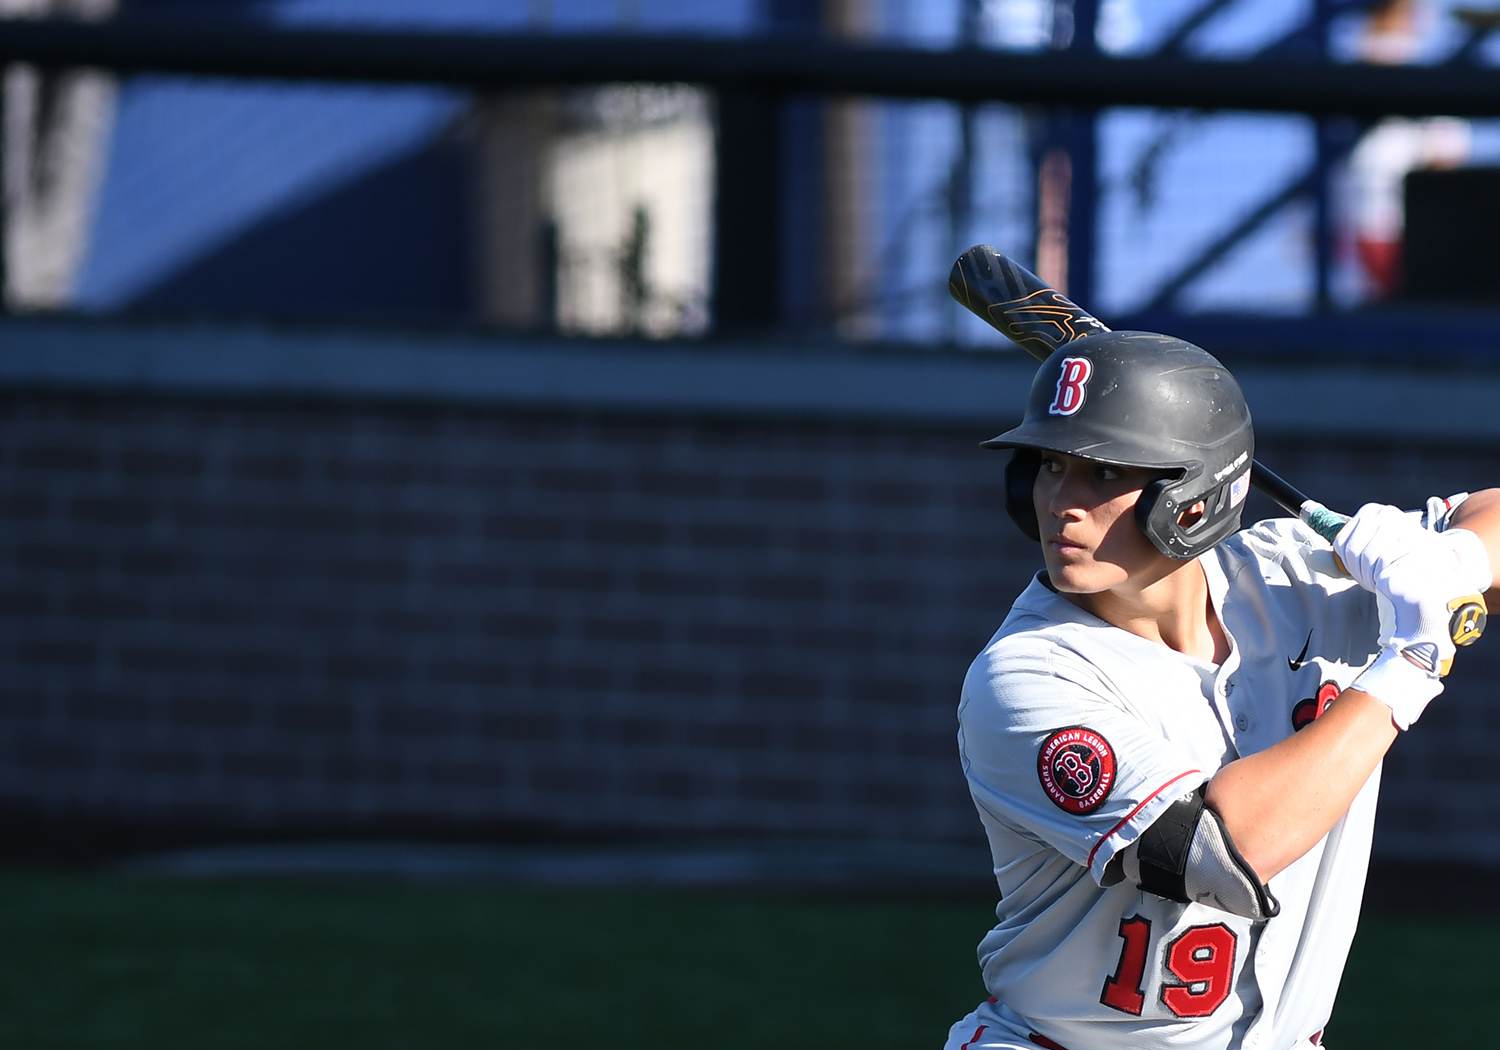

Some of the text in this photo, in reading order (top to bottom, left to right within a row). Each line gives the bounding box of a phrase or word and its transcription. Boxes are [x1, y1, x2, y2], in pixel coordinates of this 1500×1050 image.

[1049, 357, 1092, 416] B
[1042, 732, 1109, 803] BARBERS AMERICAN LEGION
[1055, 751, 1093, 794] B
[1078, 772, 1111, 809] BASEBALL
[1100, 913, 1238, 1018] 19
